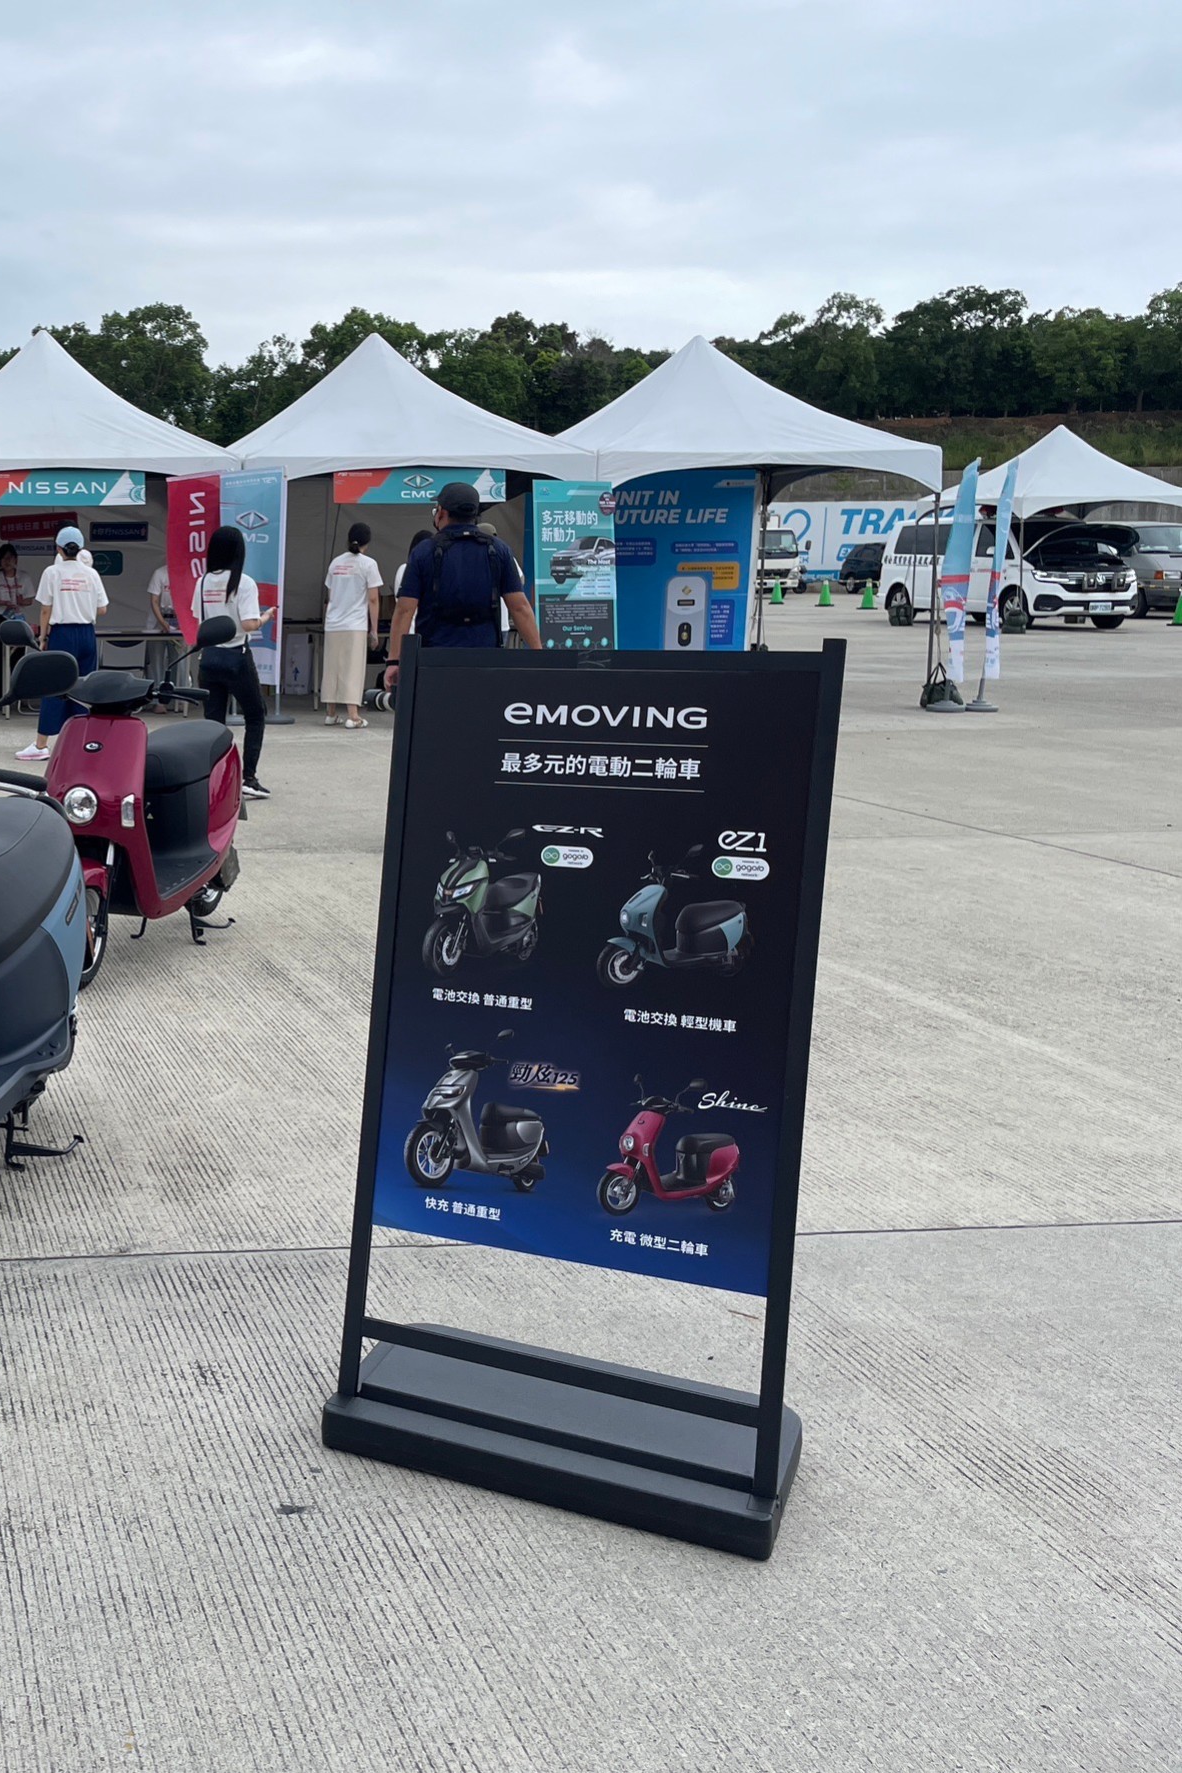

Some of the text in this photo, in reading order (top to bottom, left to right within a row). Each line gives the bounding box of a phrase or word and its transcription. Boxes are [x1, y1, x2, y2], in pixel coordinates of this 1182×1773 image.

[8, 481, 107, 495] NISSAN
[400, 490, 436, 499] CMC
[658, 490, 680, 506] IN
[541, 510, 598, 526] 多元移動的
[614, 508, 729, 525] UTURE LIFE
[840, 508, 916, 535] TRA
[541, 527, 576, 543] 新動力
[500, 752, 702, 781] 最多元的電動二輪車
[562, 853, 589, 861] gogoro
[735, 864, 765, 873] gogoro
[432, 987, 533, 1012] 電池交換 普通重型
[623, 1008, 737, 1034] 電池交換 輕型機車
[698, 1090, 768, 1113] Shine
[424, 1196, 501, 1222] 快充 普通重型
[609, 1228, 709, 1257] 充電 微型二輪車
